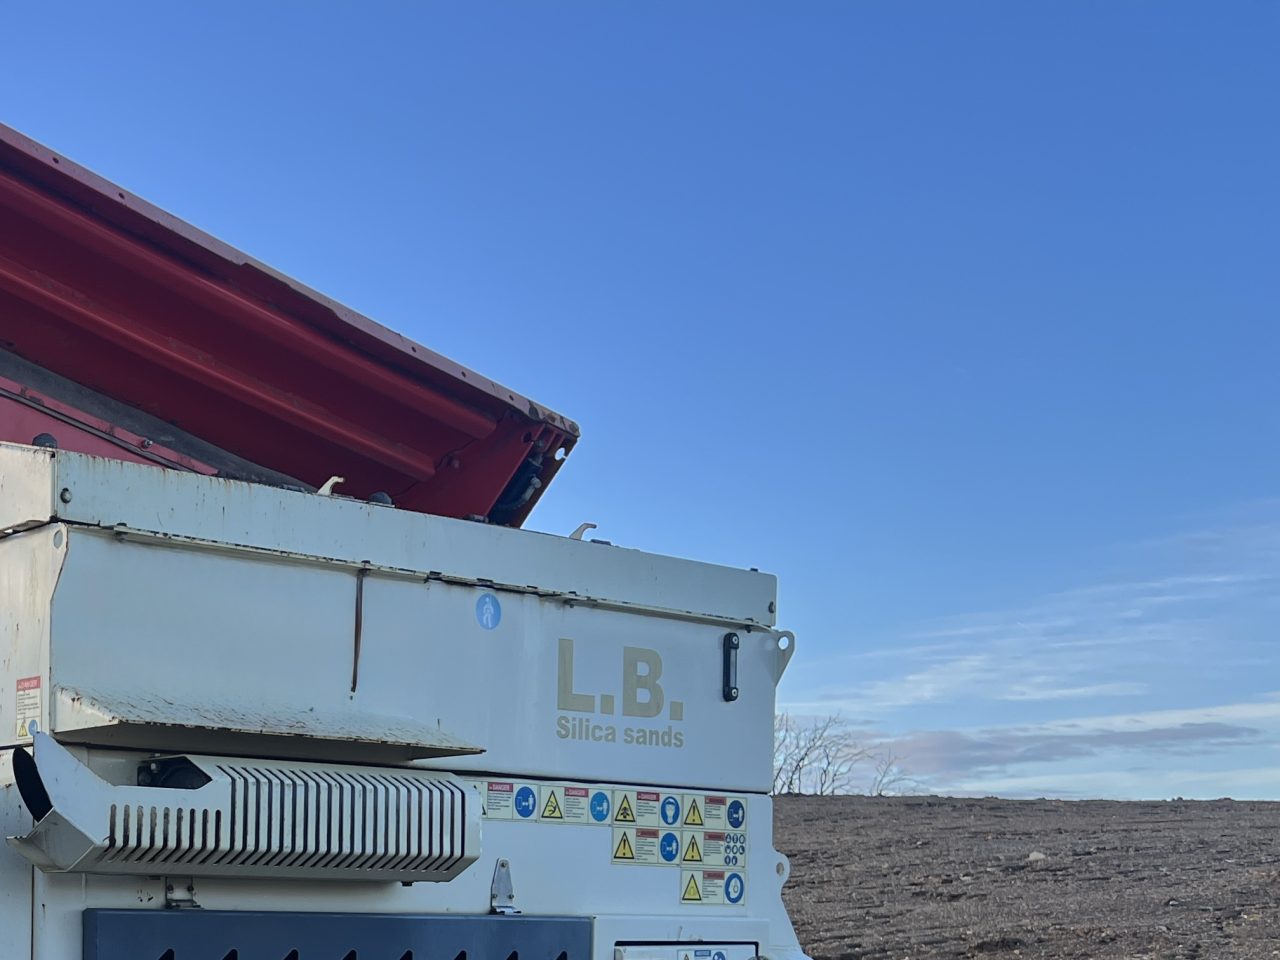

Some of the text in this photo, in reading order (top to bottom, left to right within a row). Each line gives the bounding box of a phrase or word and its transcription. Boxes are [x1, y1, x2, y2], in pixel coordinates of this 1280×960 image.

[557, 638, 684, 721] L.B.
[556, 715, 684, 748] Silica sands
